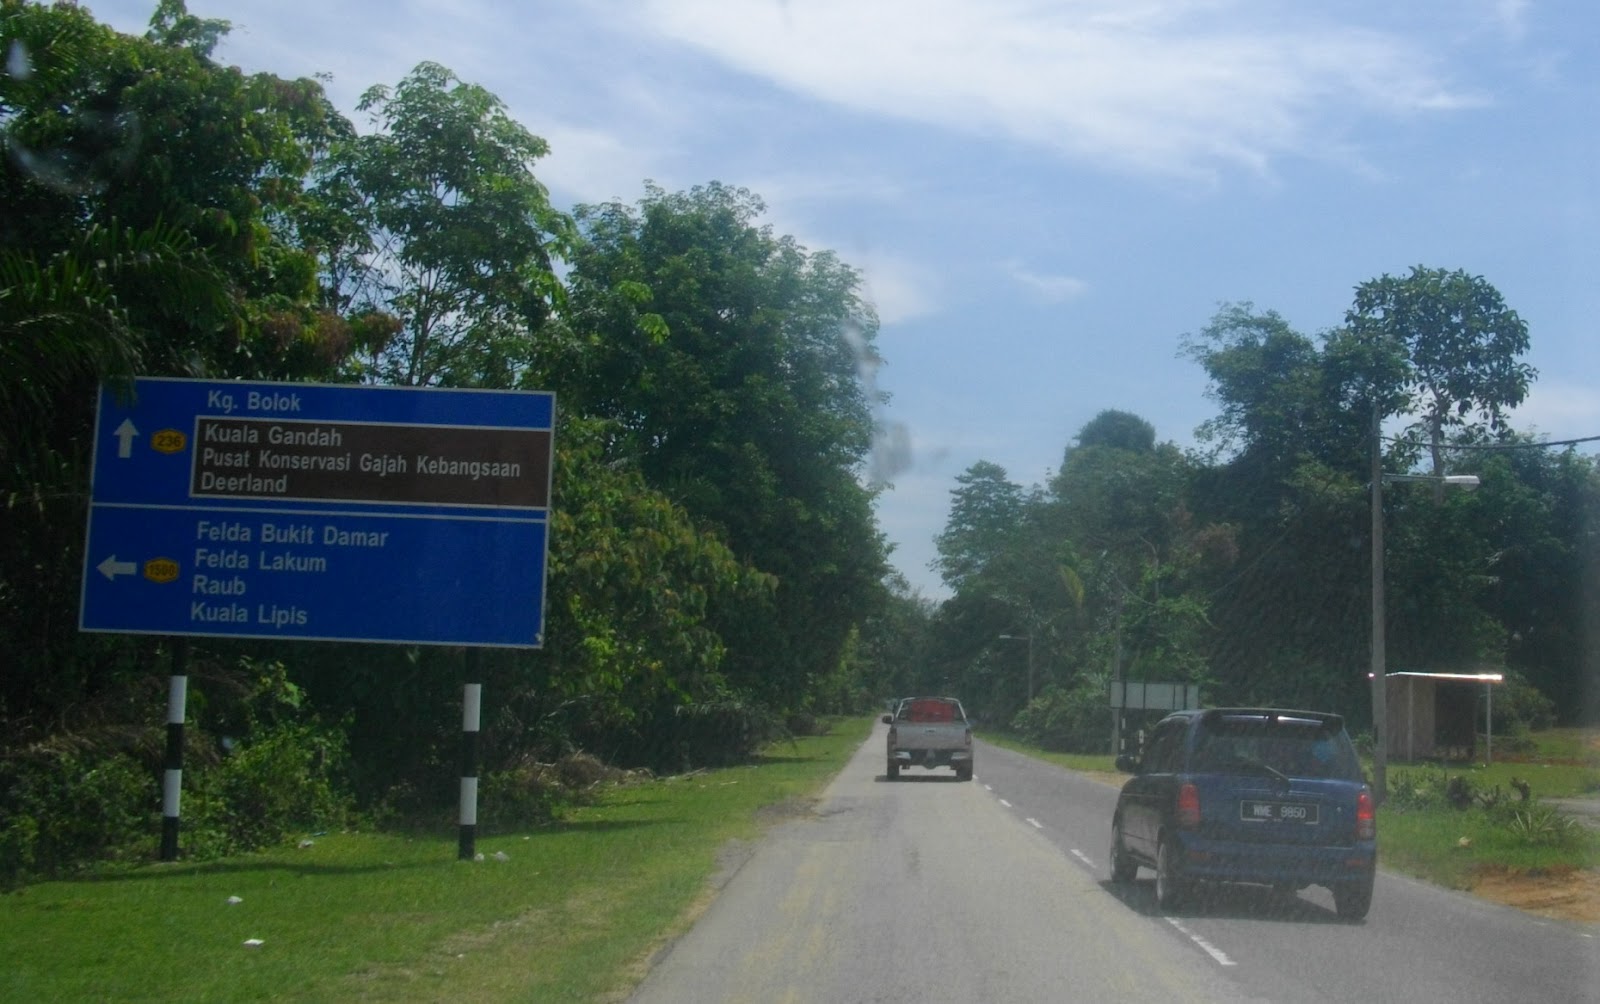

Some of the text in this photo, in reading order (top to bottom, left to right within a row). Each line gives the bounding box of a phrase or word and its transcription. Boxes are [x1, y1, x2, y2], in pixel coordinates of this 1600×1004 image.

[208, 390, 301, 413] Kg. Bolok
[205, 424, 342, 446] Kuala Gandah
[203, 448, 520, 480] Pusat Konservasi Gajah Kebangsaan
[201, 472, 287, 493] Deerland
[197, 521, 389, 547] Felda Bukit Damar
[195, 548, 327, 572] Felda Lakum
[192, 575, 246, 596] Raub
[191, 602, 308, 629] Kuala Lipis
